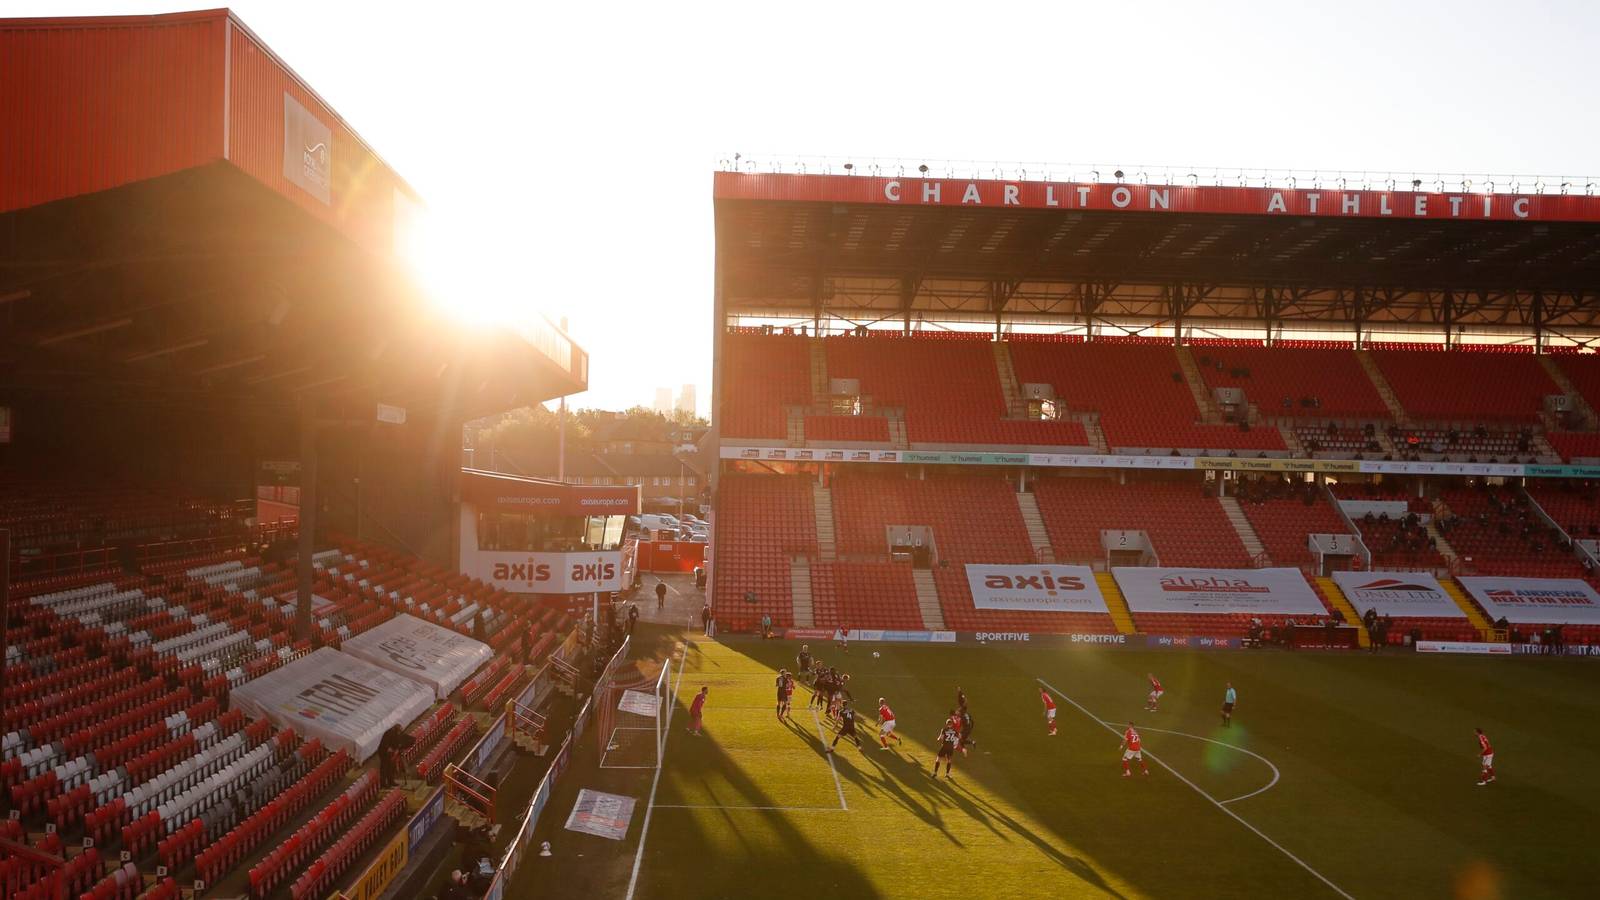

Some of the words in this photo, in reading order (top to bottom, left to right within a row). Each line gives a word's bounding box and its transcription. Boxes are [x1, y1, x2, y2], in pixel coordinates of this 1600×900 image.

[885, 181, 1169, 209] CHARLTON
[1268, 191, 1529, 218] ATHLETIC
[1553, 395, 1566, 406] 10
[958, 455, 982, 463] hummel
[1119, 536, 1127, 546] 2
[1330, 540, 1338, 550] 3
[493, 557, 551, 588] axis
[571, 557, 615, 587] axis
[985, 570, 1086, 596] axis
[1159, 575, 1251, 589] alpha
[1516, 589, 1587, 598] ANDREWS
[975, 632, 1030, 641] SPORTFIVE
[1071, 634, 1125, 643] SPORTFIVE
[1159, 637, 1172, 646] sky
[1173, 637, 1188, 645] bet
[1200, 637, 1213, 647] sky
[1214, 638, 1228, 646] bet
